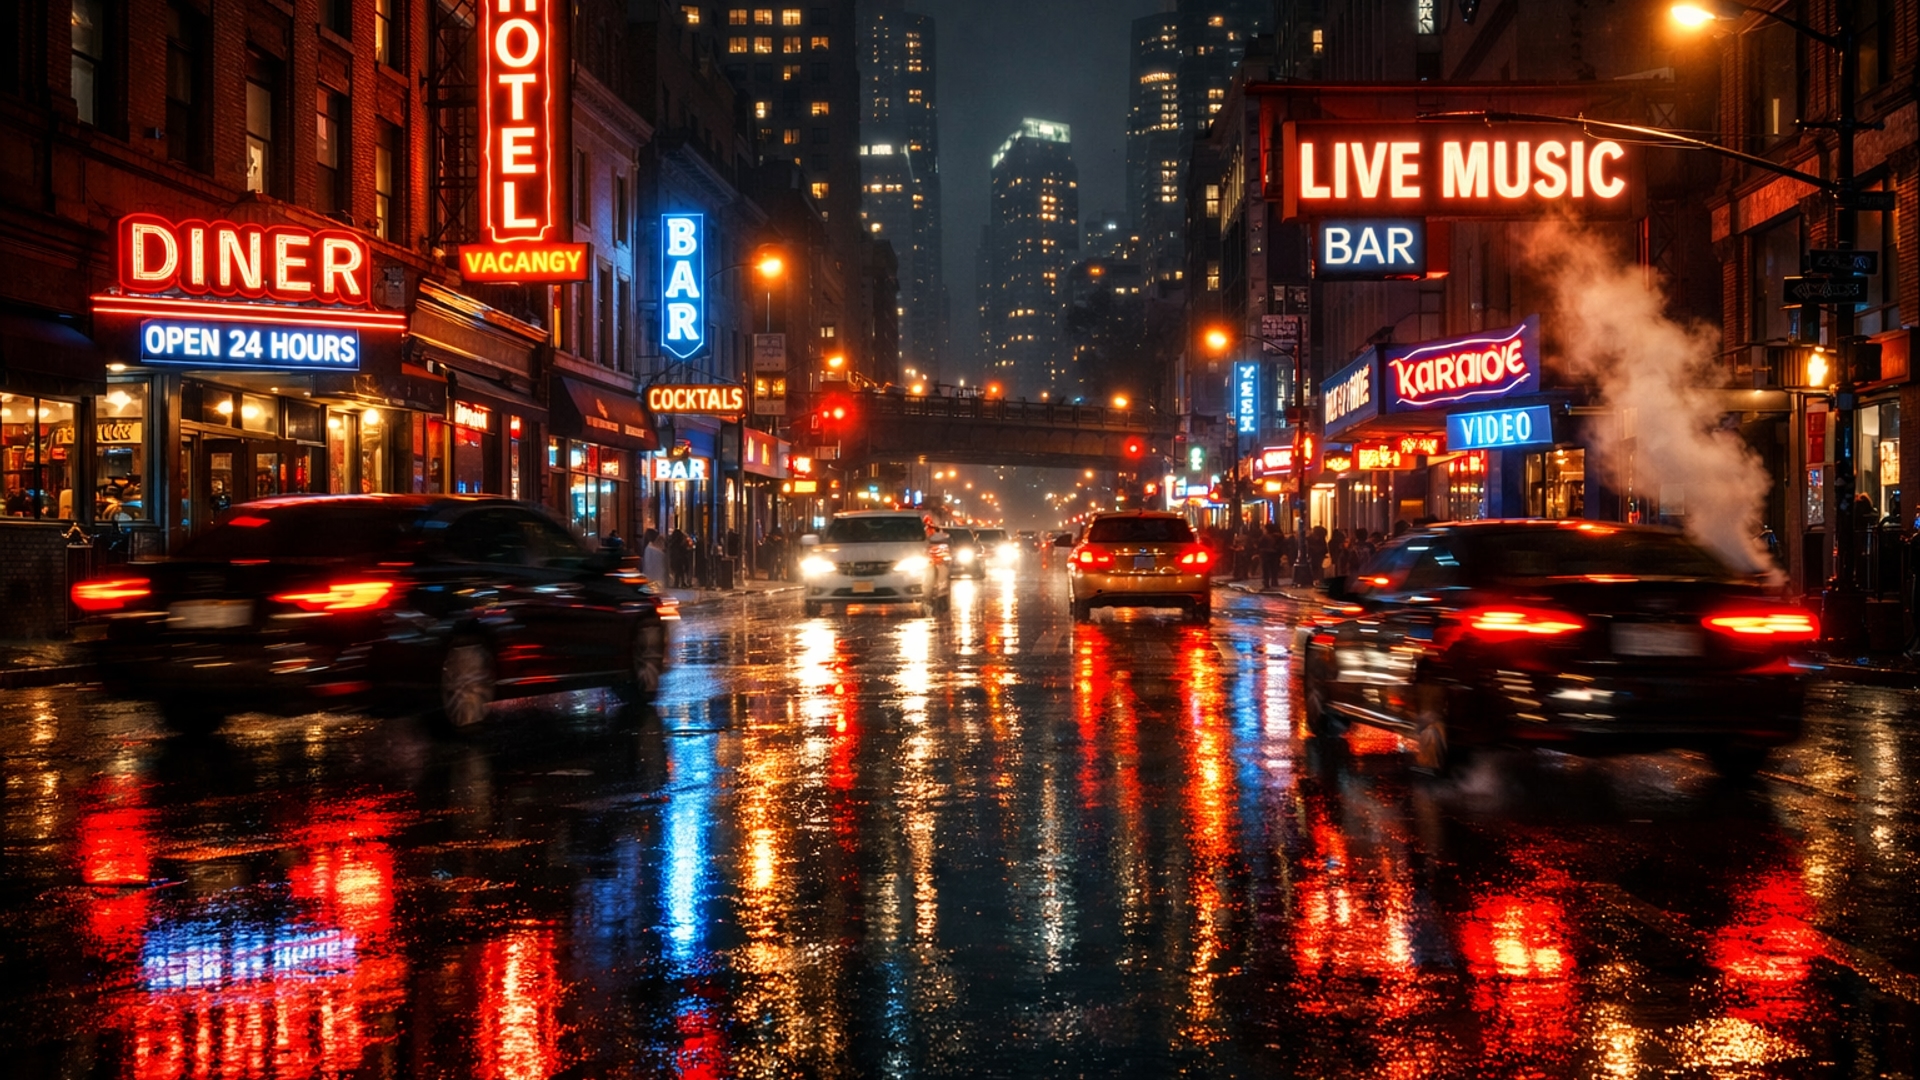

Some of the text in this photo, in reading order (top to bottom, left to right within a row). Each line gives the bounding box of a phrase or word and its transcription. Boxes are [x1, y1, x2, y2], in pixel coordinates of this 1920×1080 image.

[496, 0, 540, 229] OTEL
[1300, 140, 1626, 199] LIVE MUSIC
[132, 223, 363, 295] DINER
[1325, 227, 1415, 265] BAR
[666, 218, 700, 340] BAR
[145, 325, 356, 363] OPEN 24 HOURS
[1461, 411, 1531, 445] VIDEO
[655, 457, 705, 479] BAR
